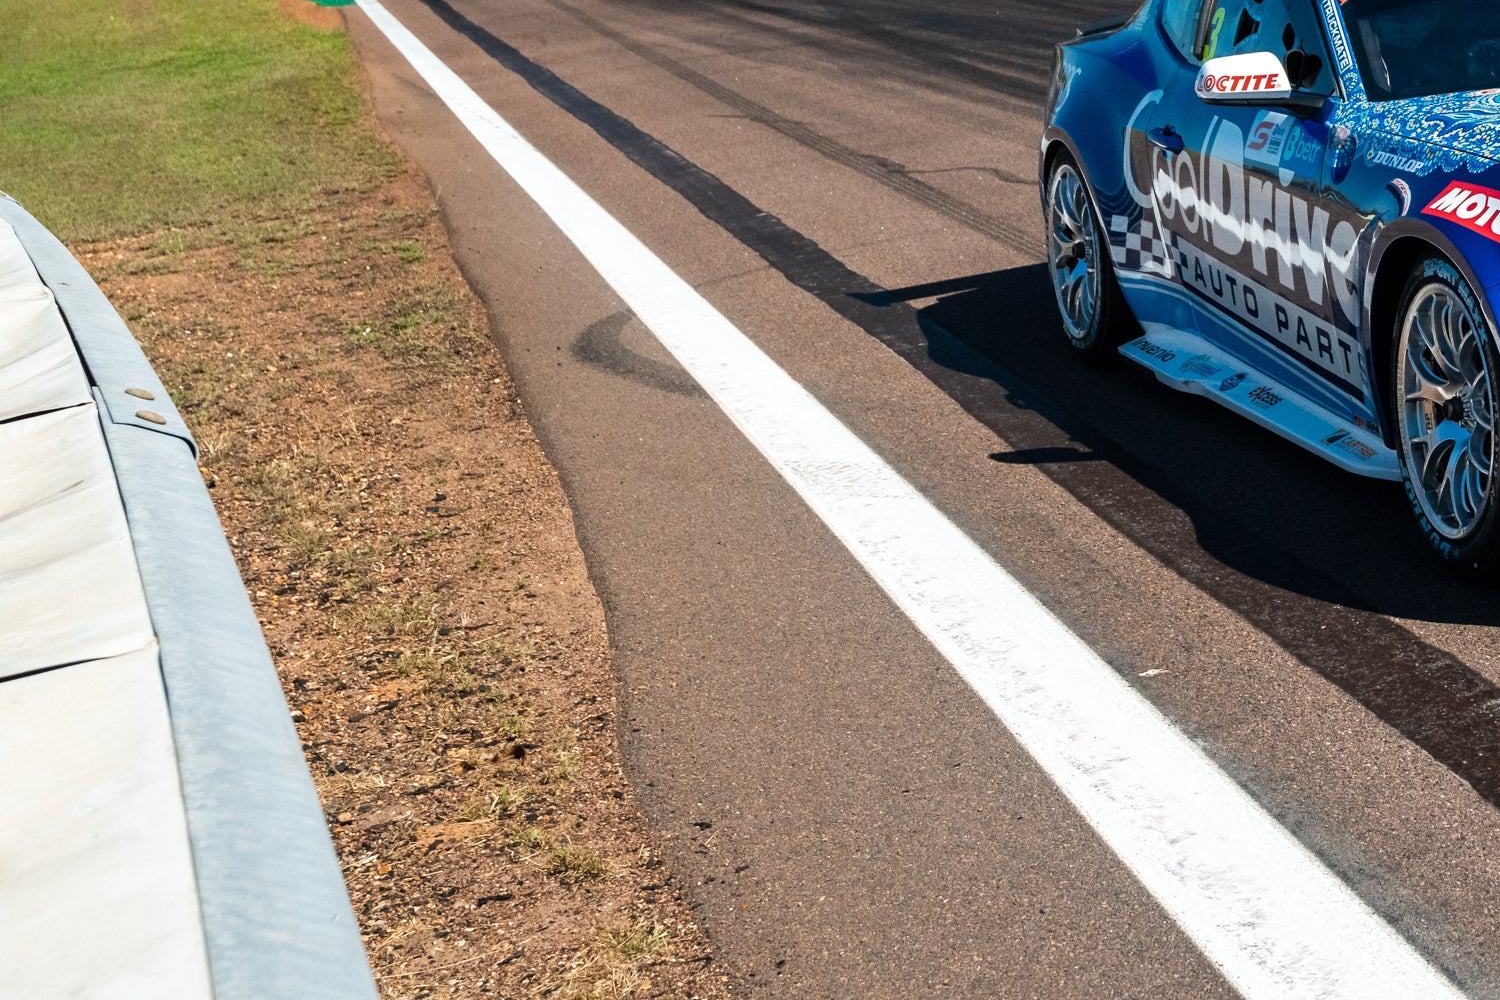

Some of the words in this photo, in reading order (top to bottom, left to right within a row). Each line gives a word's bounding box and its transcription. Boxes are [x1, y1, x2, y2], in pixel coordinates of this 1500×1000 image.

[1323, 0, 1349, 69] TRUCKMATE
[1197, 73, 1279, 92] LOCTITE
[1295, 132, 1320, 163] betr
[1373, 151, 1424, 173] DUNLOP
[1193, 257, 1260, 318] AUTO
[1131, 338, 1176, 363] invenio
